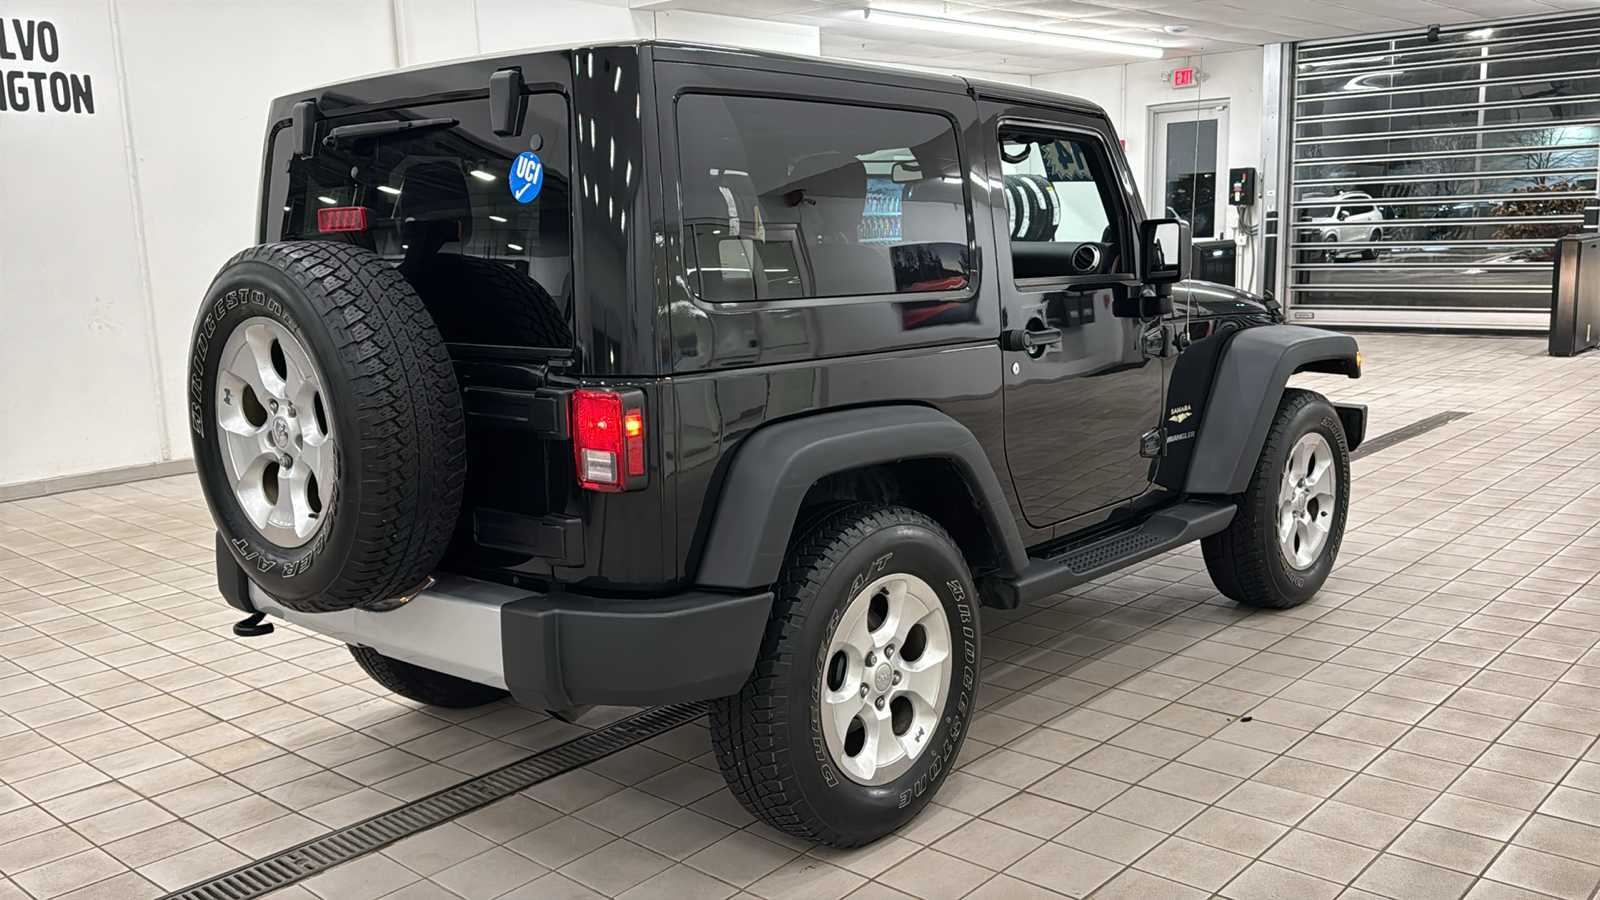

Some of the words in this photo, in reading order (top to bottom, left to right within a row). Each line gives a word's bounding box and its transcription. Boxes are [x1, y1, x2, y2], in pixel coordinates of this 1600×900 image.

[0, 17, 59, 63] LVO
[1174, 68, 1193, 86] EXIT
[516, 155, 541, 185] UCI
[1170, 404, 1192, 415] SAHARA
[231, 538, 277, 573] A/T
[846, 551, 894, 604] A/T
[898, 578, 976, 809] BRIDGESTONE
